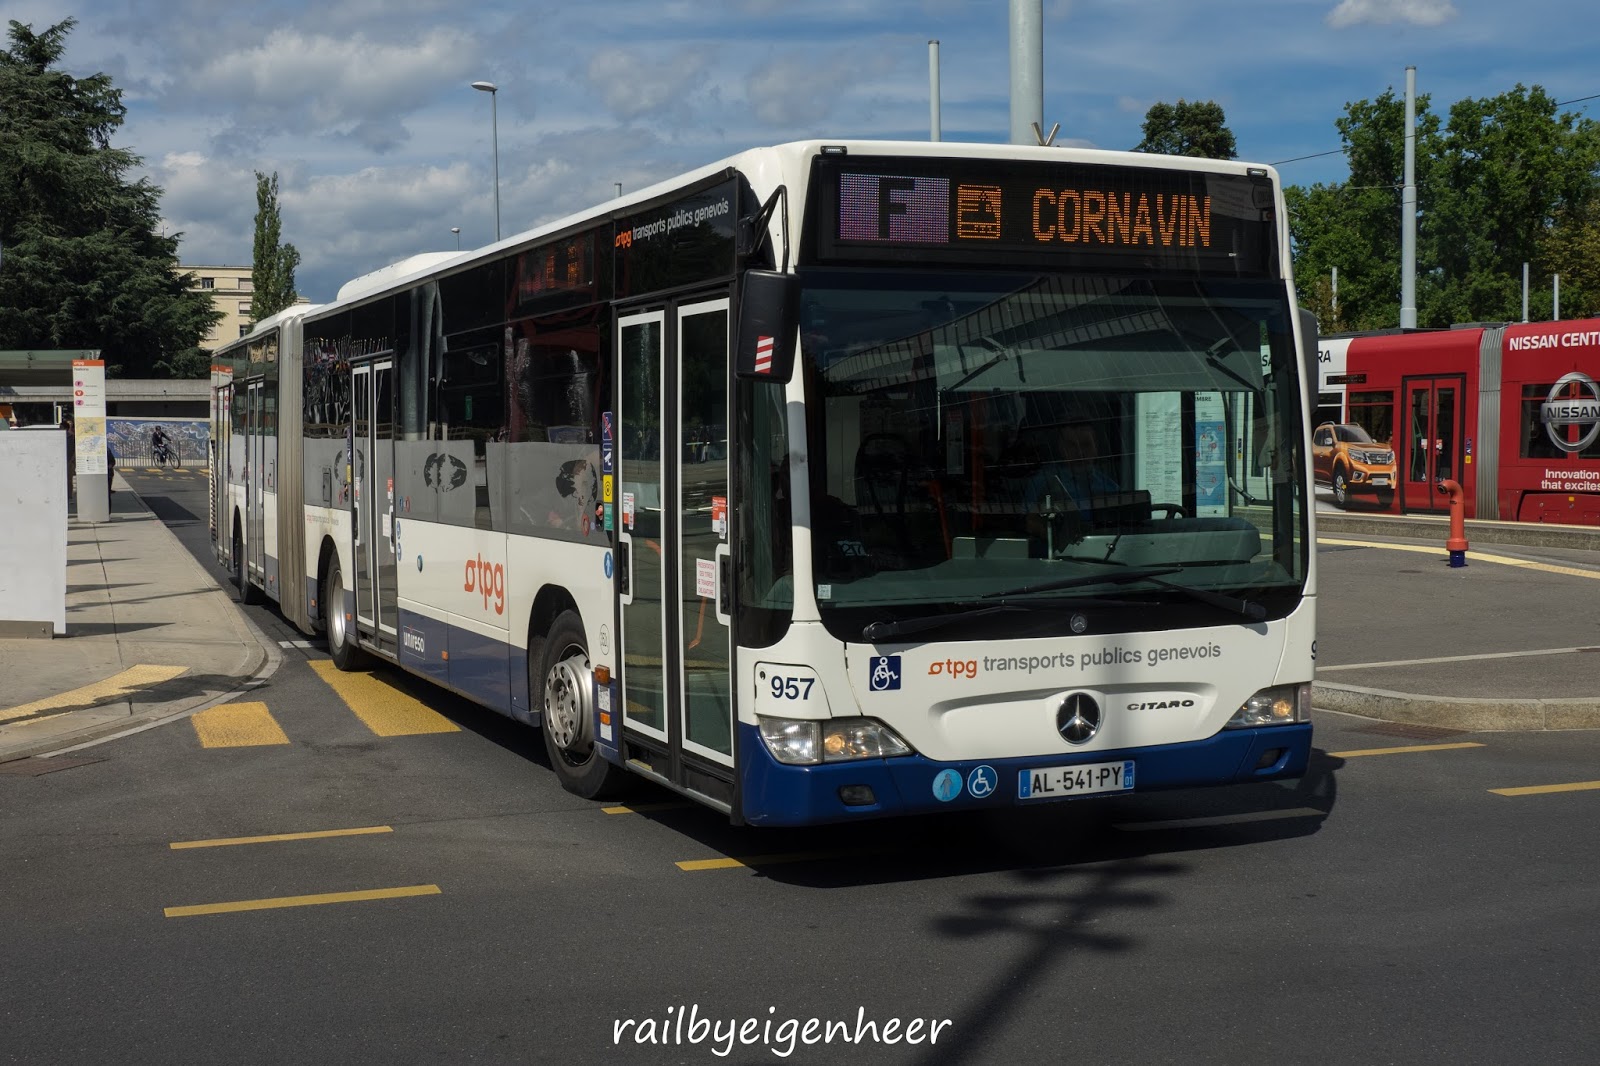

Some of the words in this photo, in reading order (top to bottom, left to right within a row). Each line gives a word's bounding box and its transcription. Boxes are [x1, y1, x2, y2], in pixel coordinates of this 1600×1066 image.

[633, 218, 666, 241] transports
[667, 209, 693, 235] publics
[694, 198, 729, 227] genevois
[879, 176, 916, 240] F
[1032, 188, 1211, 247] CORNAVIN
[1509, 334, 1559, 351] NISSAN
[1547, 406, 1600, 418] NISSAN
[1541, 480, 1562, 489] that
[1545, 469, 1600, 480] Innovation
[983, 652, 1075, 674] transports
[1081, 647, 1142, 671] publics
[1147, 642, 1221, 667] genevois
[771, 675, 815, 701] 957
[1126, 699, 1195, 711] CITARO
[1032, 766, 1122, 794] AL-541-PY
[1124, 776, 1133, 786] 01
